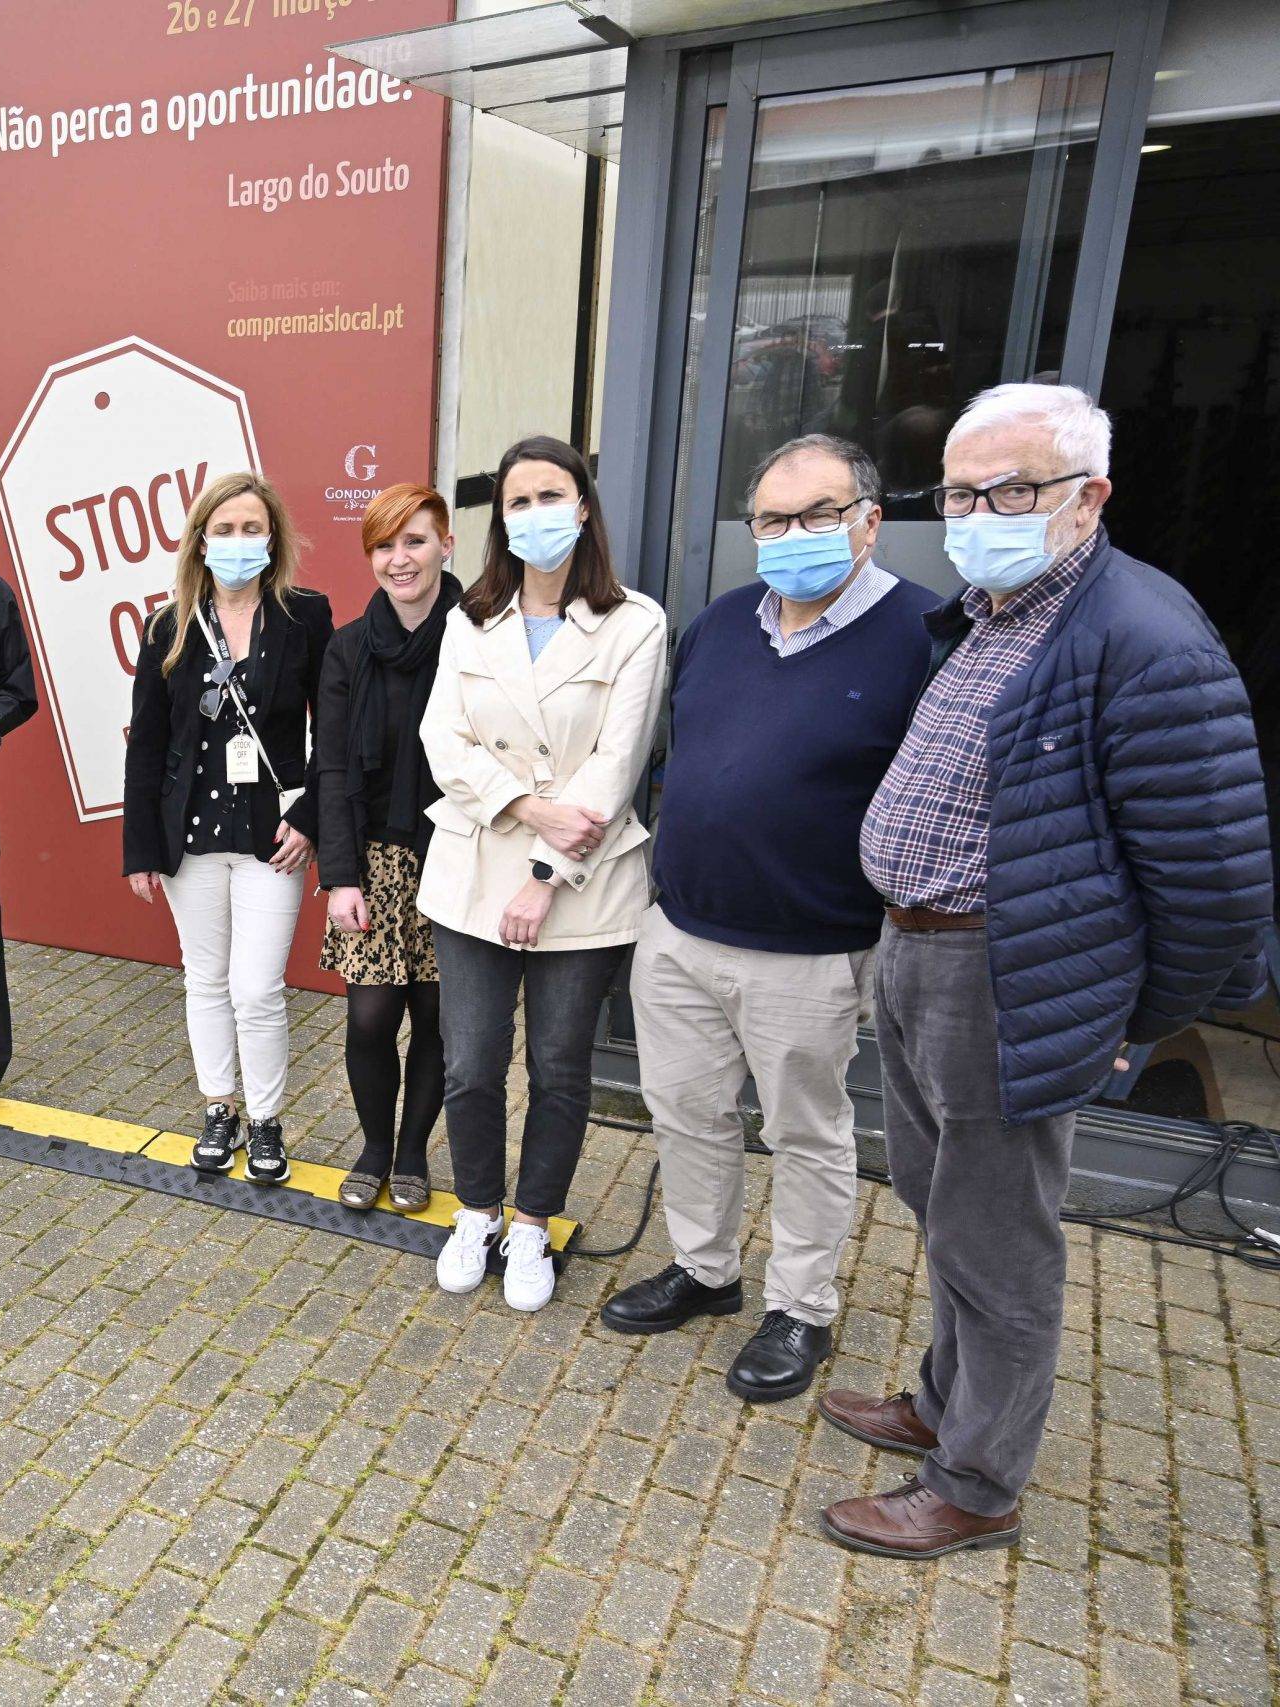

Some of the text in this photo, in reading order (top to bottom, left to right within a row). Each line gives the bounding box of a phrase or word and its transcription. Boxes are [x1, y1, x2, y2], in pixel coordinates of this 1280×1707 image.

[166, 0, 201, 35] 26
[207, 9, 217, 29] e
[223, 0, 255, 28] 27
[51, 102, 132, 157] perca
[140, 99, 158, 135] a
[228, 157, 410, 213] Largo do Souto
[228, 277, 342, 303] Saiba mais em:
[227, 302, 405, 342] compremaislocal.pt
[344, 444, 379, 481] G
[232, 741, 251, 750] STOCK
[236, 750, 247, 759] OFF
